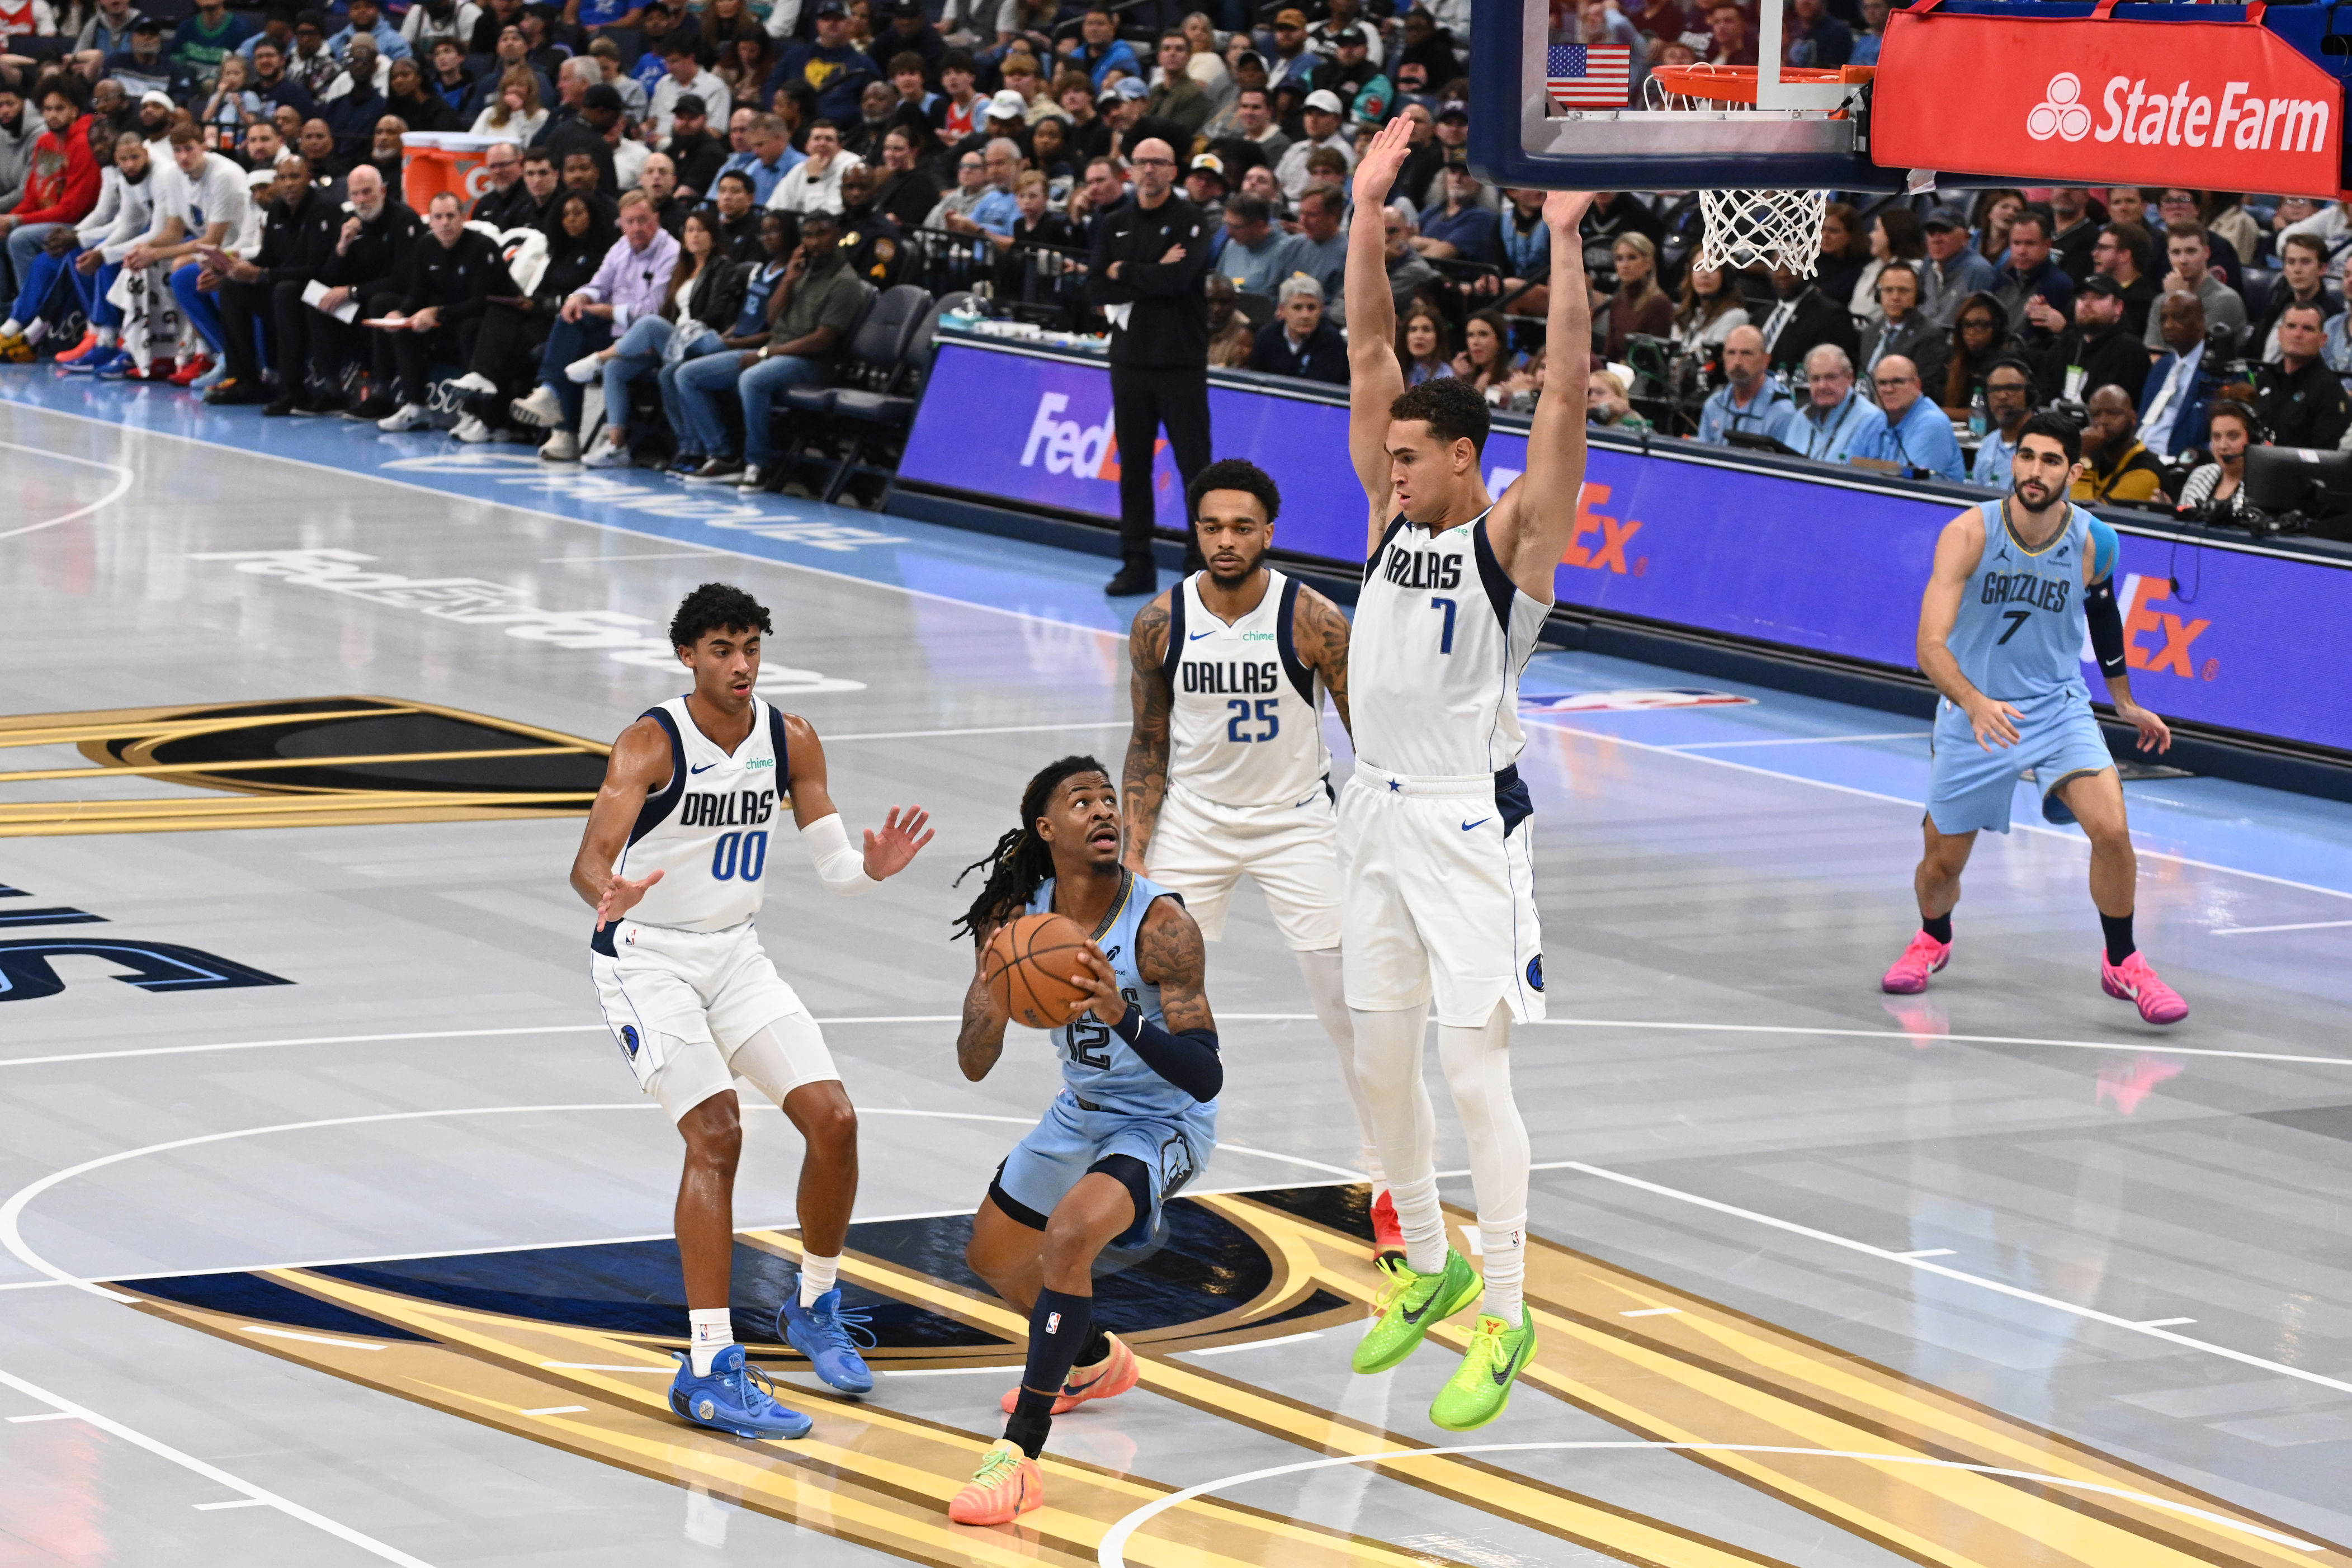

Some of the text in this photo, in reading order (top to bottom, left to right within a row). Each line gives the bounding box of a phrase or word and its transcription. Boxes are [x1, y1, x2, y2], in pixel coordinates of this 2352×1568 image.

[1243, 630, 1275, 641] chime
[1430, 596, 1457, 655] 7
[1997, 611, 2031, 645] 7
[1182, 662, 1278, 695] DALLAS
[1227, 698, 1279, 744] 25
[746, 757, 774, 770] chime
[679, 789, 774, 827] DALLAS
[711, 830, 769, 882] 00
[1066, 1022, 1111, 1071] 12
